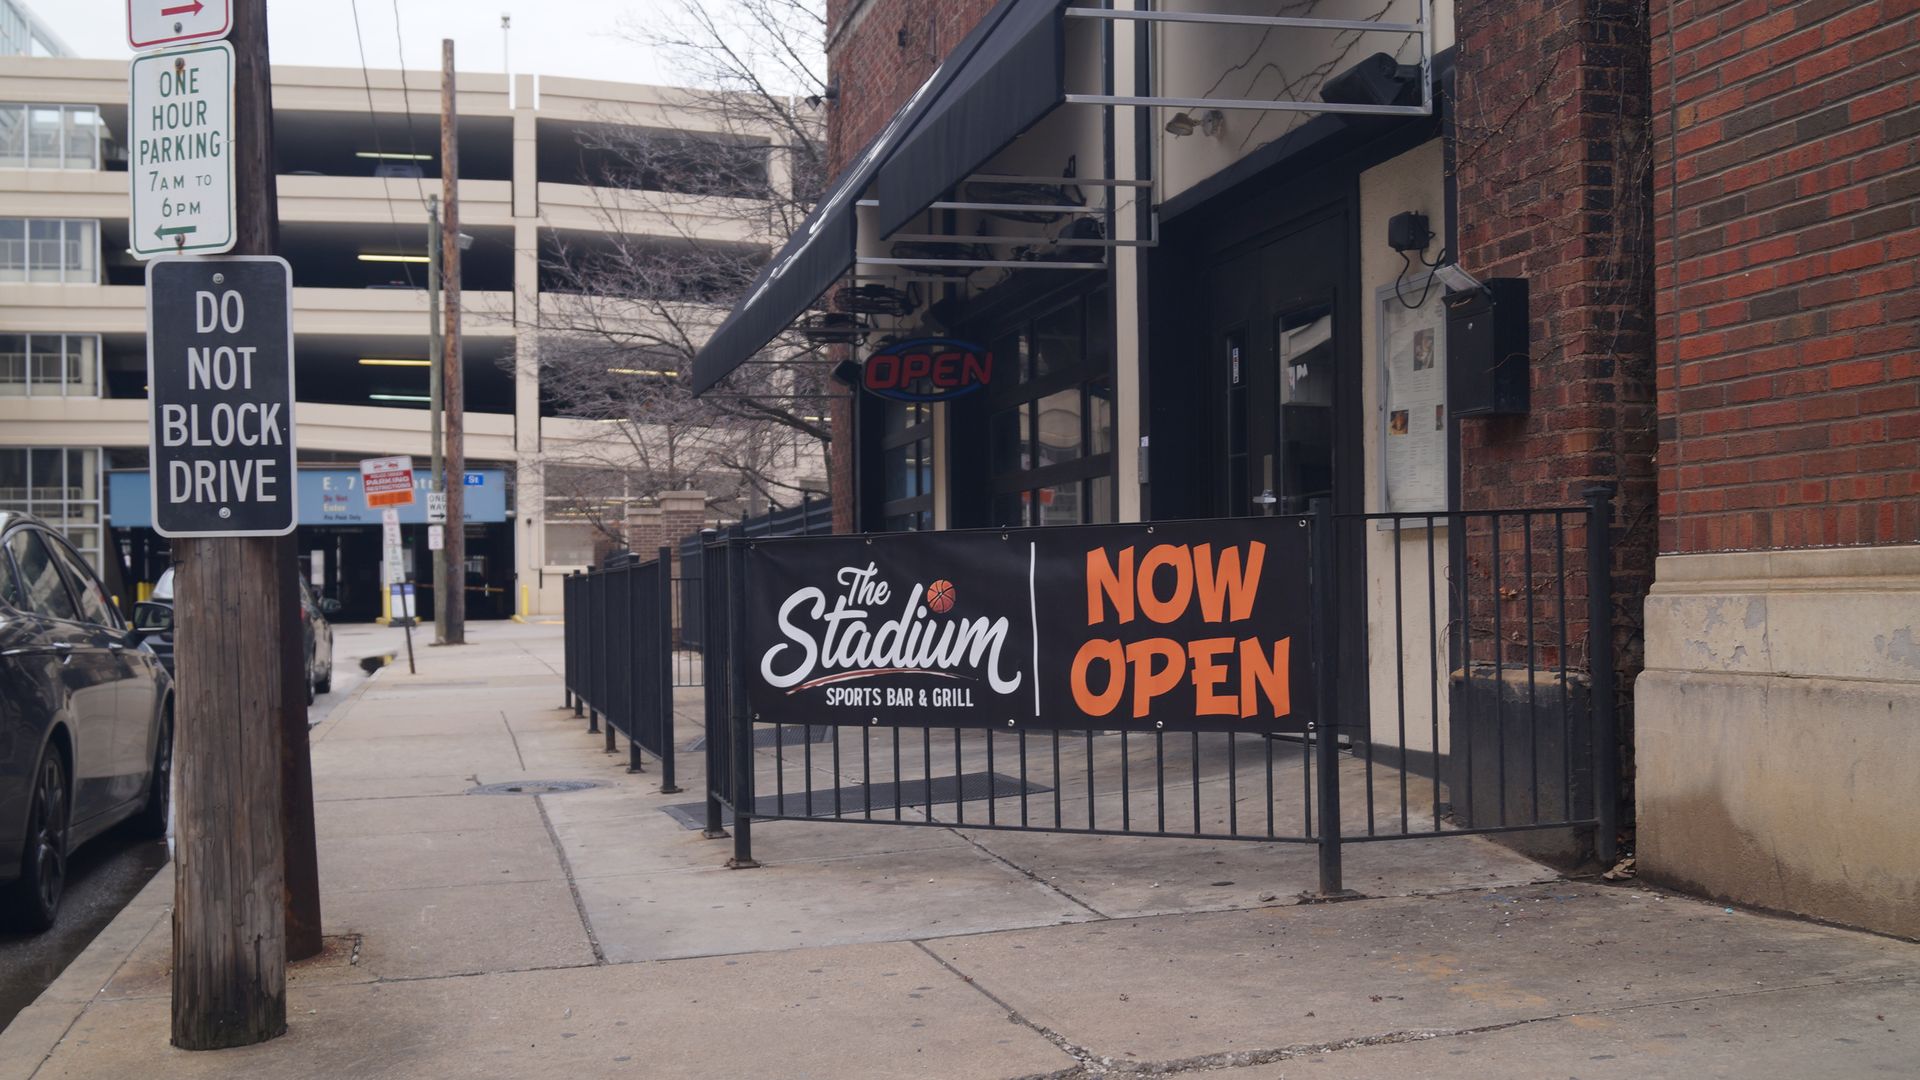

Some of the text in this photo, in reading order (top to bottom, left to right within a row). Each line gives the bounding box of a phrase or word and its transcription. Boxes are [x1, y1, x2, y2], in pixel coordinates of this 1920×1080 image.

[160, 68, 199, 98] ONE
[152, 100, 207, 131] HOUR
[140, 131, 221, 165] PARKING
[195, 174, 212, 187] TO
[196, 290, 245, 334] DO
[187, 346, 257, 391] NOT
[865, 352, 993, 389] OPEN
[162, 403, 283, 447] BLOCK
[169, 459, 277, 503] DRIVE
[468, 475, 479, 484] St
[837, 561, 891, 606] The
[1087, 540, 1267, 626] NOW
[760, 582, 1022, 695] Stadium
[826, 687, 974, 707] SPORTS BAR & GRILL
[1070, 636, 1291, 719] OPEN
